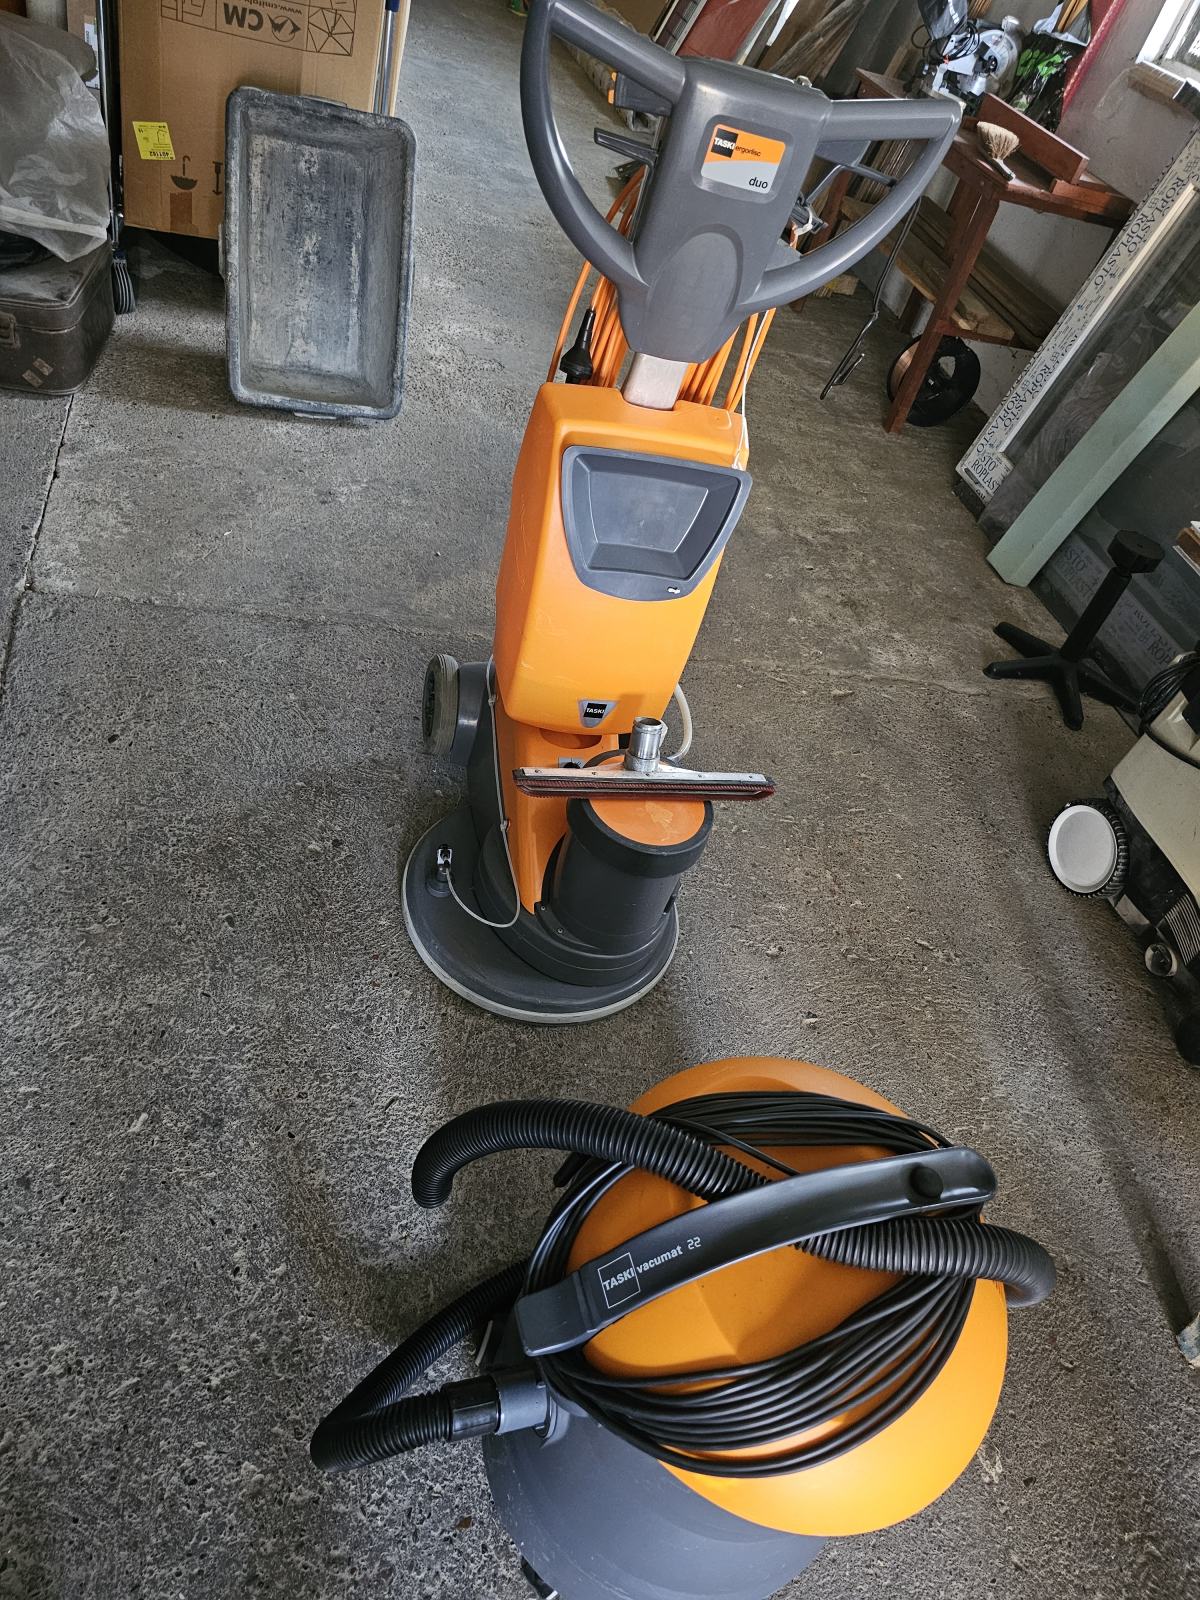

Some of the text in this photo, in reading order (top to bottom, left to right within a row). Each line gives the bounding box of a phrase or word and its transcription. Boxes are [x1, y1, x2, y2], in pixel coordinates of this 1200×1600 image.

[223, 2, 264, 31] CM
[714, 137, 736, 150] TASKI
[749, 177, 768, 189] duo
[1094, 212, 1151, 286] ROPLASTO
[976, 391, 1024, 453] ROPLASTO
[1003, 364, 1053, 428] ROPLASTO
[603, 1236, 701, 1290] TASKI vacumat 22
